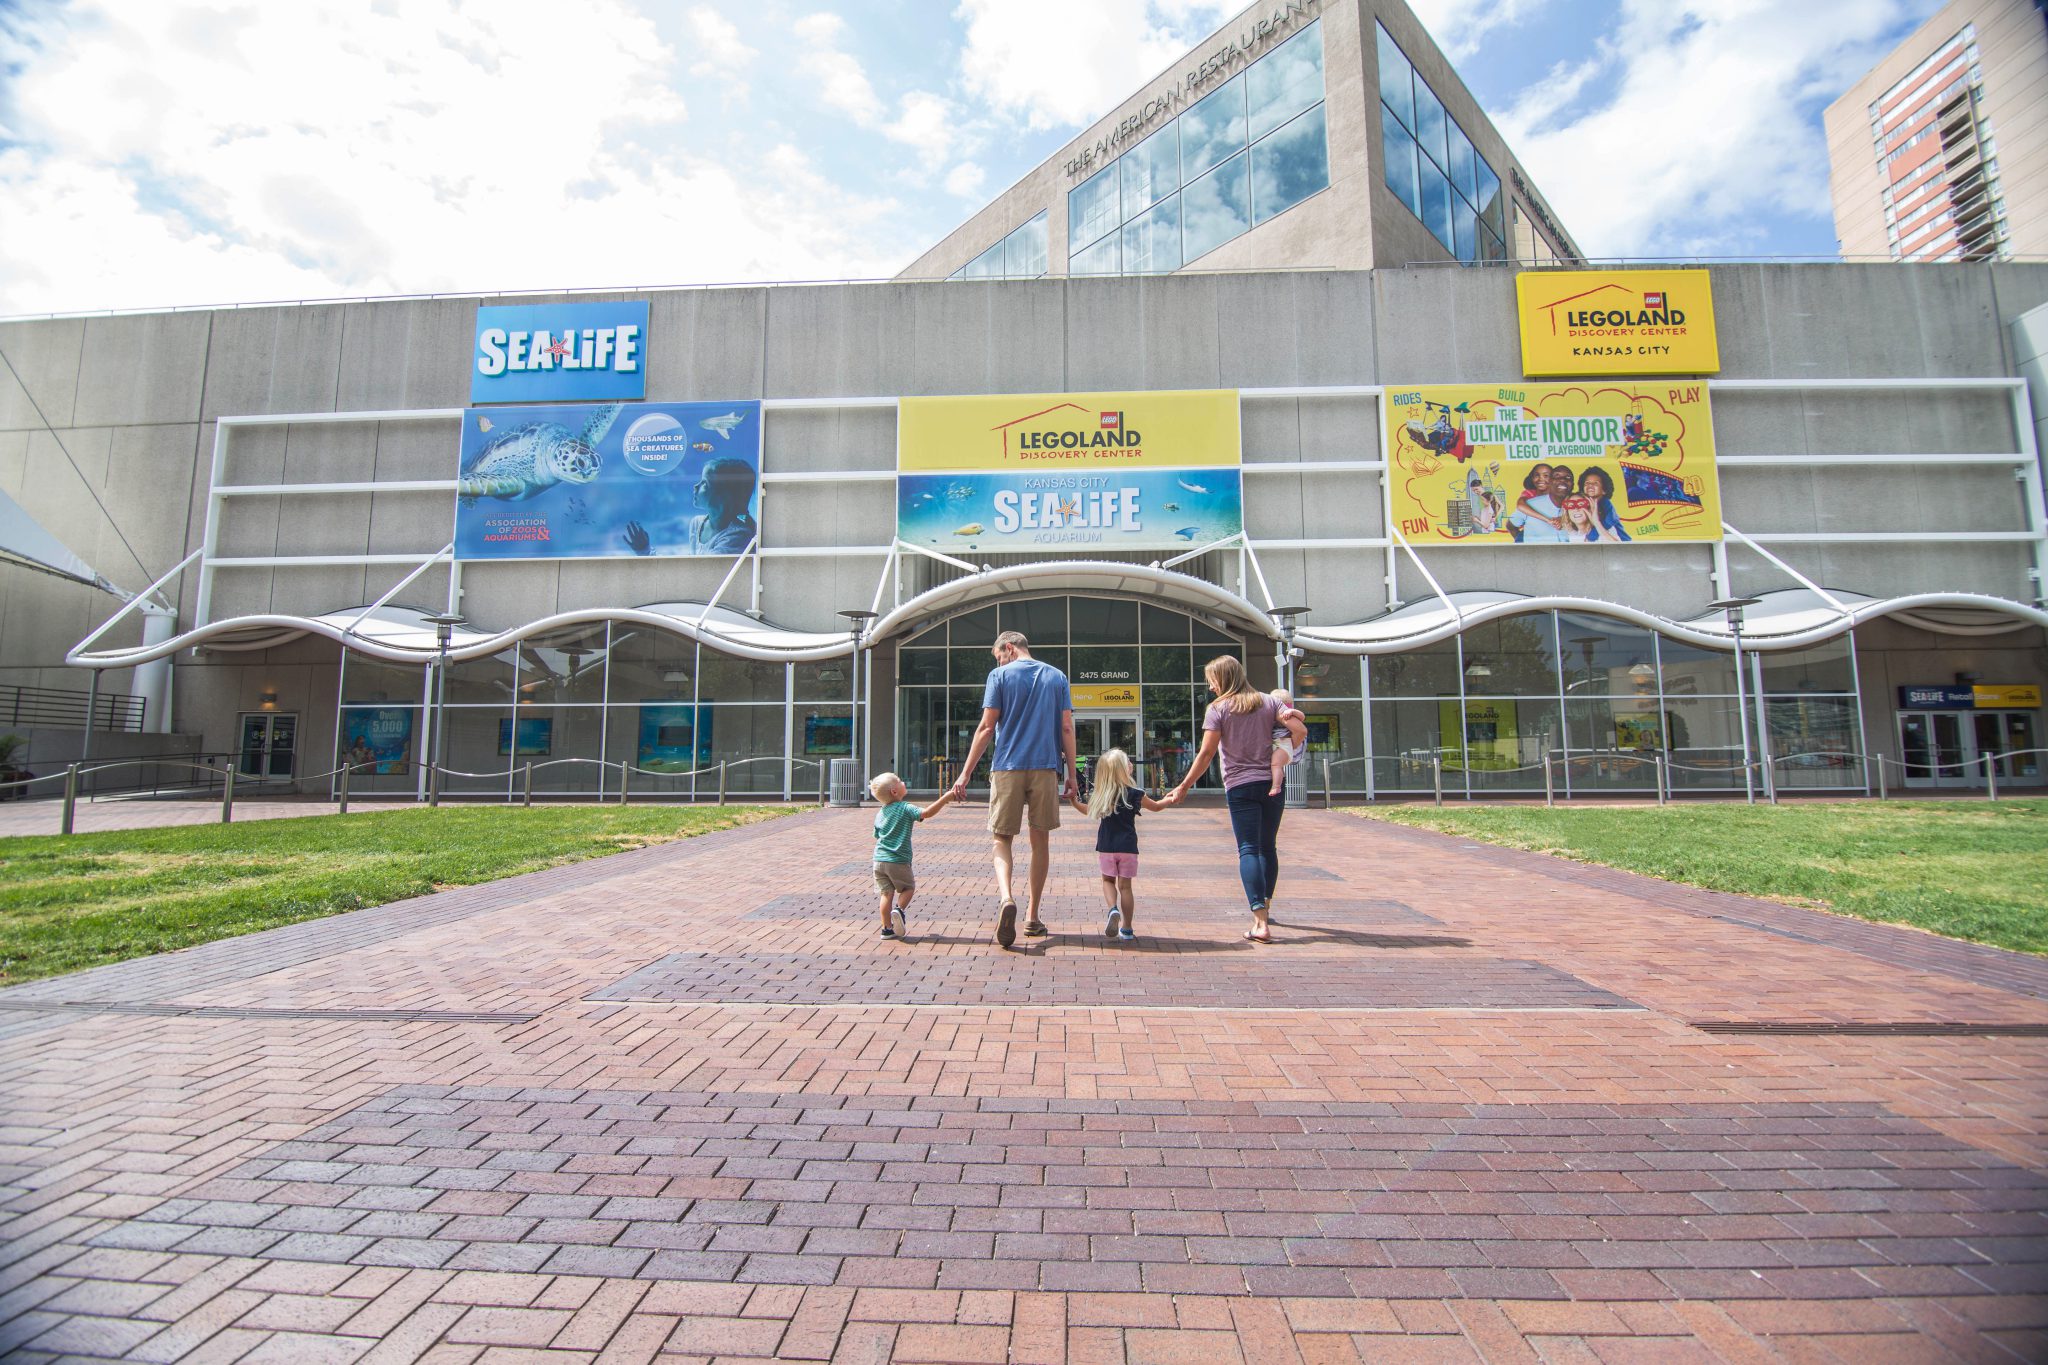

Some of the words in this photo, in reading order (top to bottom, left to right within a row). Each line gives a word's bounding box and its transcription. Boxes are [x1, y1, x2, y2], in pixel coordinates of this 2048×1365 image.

[1064, 145, 1091, 177] THE
[1094, 81, 1181, 157] AMERICAN
[1186, 0, 1314, 91] RESTAURAN
[1568, 291, 1686, 327] LEGOLAND
[1568, 328, 1635, 337] DISCOVERY
[1640, 327, 1687, 336] CENTER
[477, 327, 555, 377] SEA
[1573, 346, 1633, 356] KANSAS
[1638, 345, 1670, 355] CITY
[1393, 392, 1422, 407] RIDES
[1498, 388, 1525, 403] BUILD
[1668, 386, 1701, 405] PLAY
[1101, 415, 1117, 424] LEGO
[1499, 408, 1518, 421] THE
[1020, 411, 1142, 449] LEGOLAND
[1469, 423, 1537, 443] ULTIMATE
[1541, 418, 1620, 443] INDOOR
[627, 435, 672, 443] THOUSANDS
[641, 444, 684, 452] CREATURES
[1020, 450, 1088, 460] DISCOVERY
[1094, 449, 1142, 459] CENTER
[1509, 444, 1540, 459] LEGO
[1547, 444, 1602, 456] PLAYGROUND
[1024, 478, 1077, 489] KANSAS
[1079, 477, 1109, 488] CITY
[993, 489, 1064, 535] SEA
[485, 518, 546, 527] ASSOCIATION
[1401, 517, 1430, 536] FUN
[512, 526, 537, 534] ZOOS
[537, 526, 550, 541] &
[1636, 523, 1660, 536] LEARN
[484, 534, 537, 542] AQUARIUMS
[1033, 532, 1102, 544] AQUARIUM
[1080, 671, 1099, 679] 2475
[1100, 671, 1130, 679] GRAND
[1104, 692, 1134, 700] LEGOLAND
